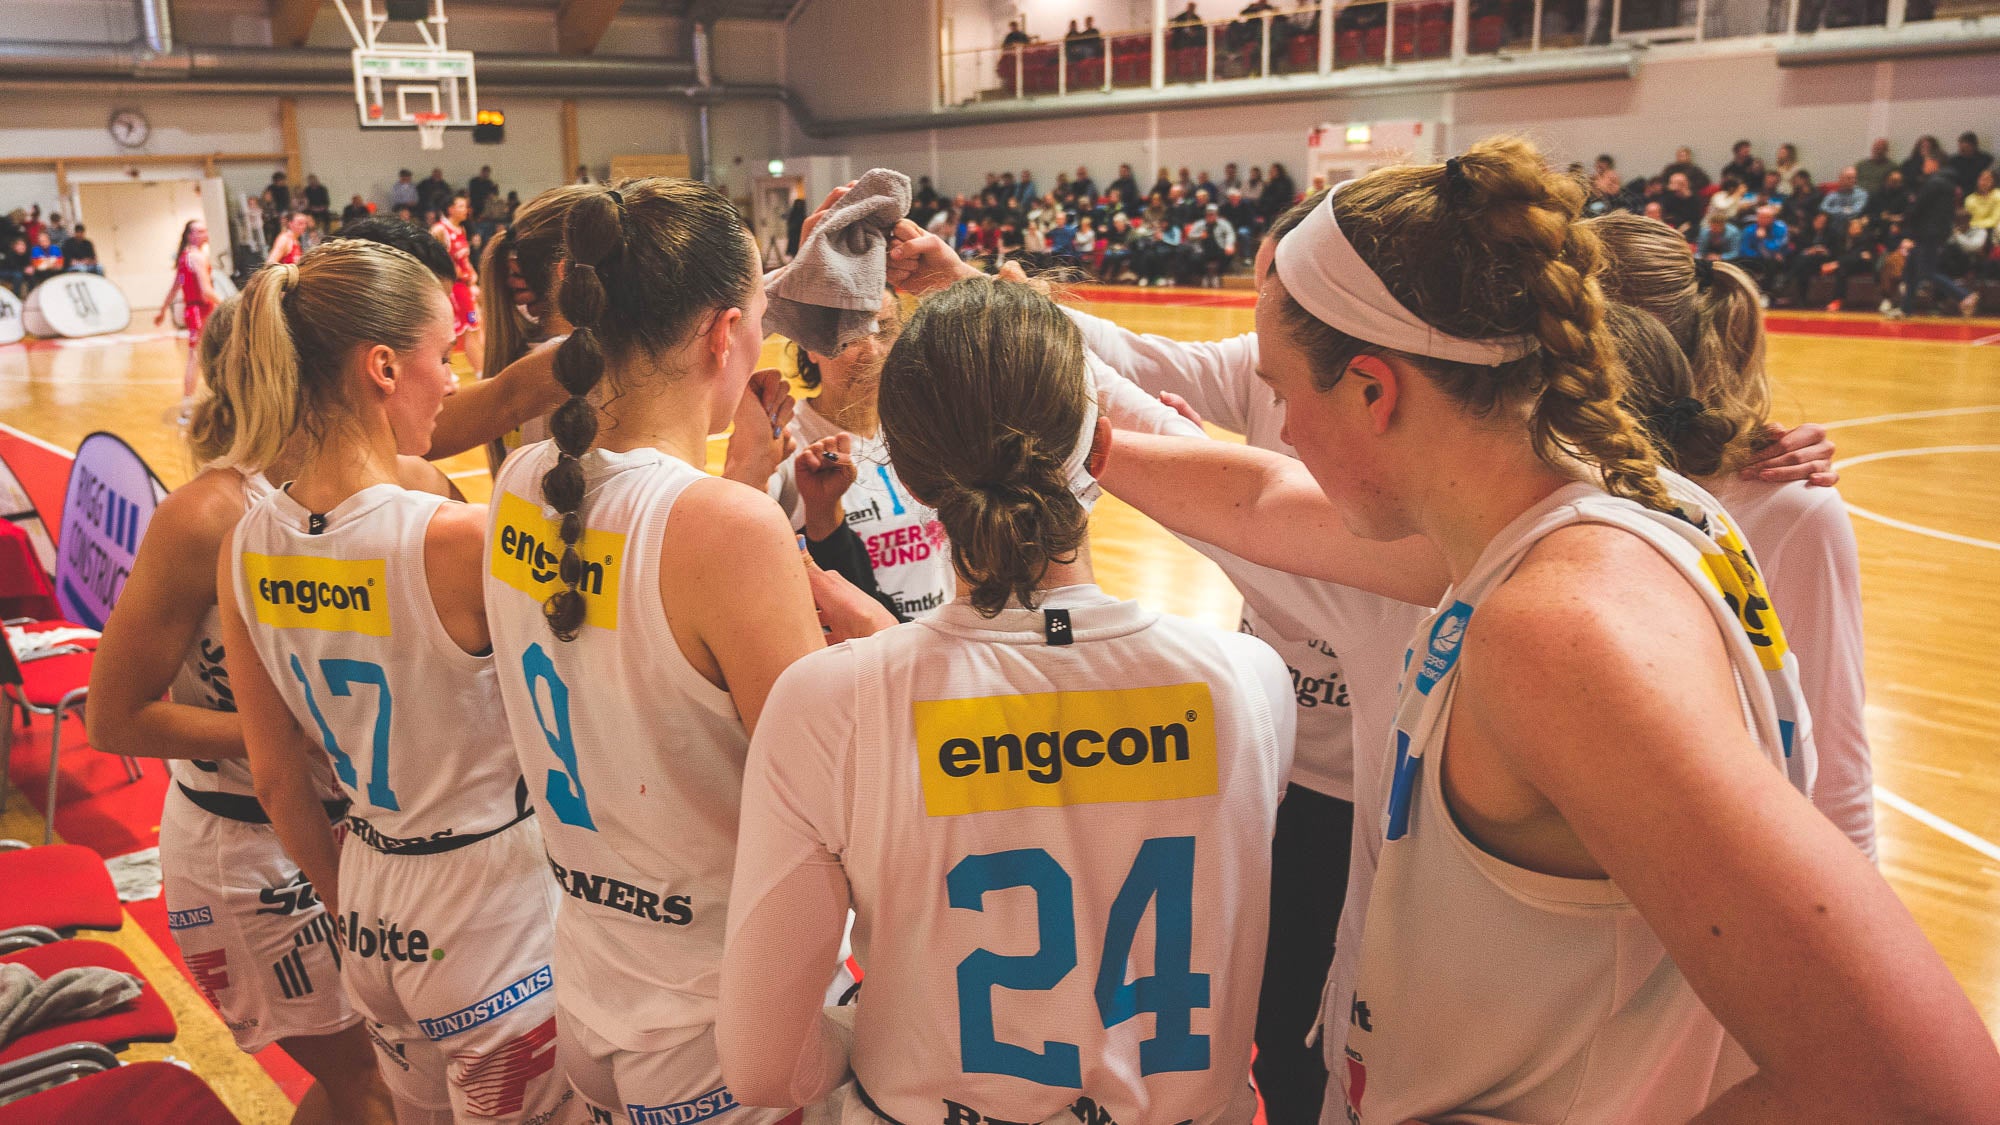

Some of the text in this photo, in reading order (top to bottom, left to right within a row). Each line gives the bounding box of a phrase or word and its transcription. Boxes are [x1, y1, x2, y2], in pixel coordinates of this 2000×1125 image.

[866, 525, 923, 554] STER
[290, 653, 401, 812] 17
[521, 642, 600, 833] 9
[420, 968, 551, 1040] LUNDSTAMS
[946, 836, 1211, 1089] 24
